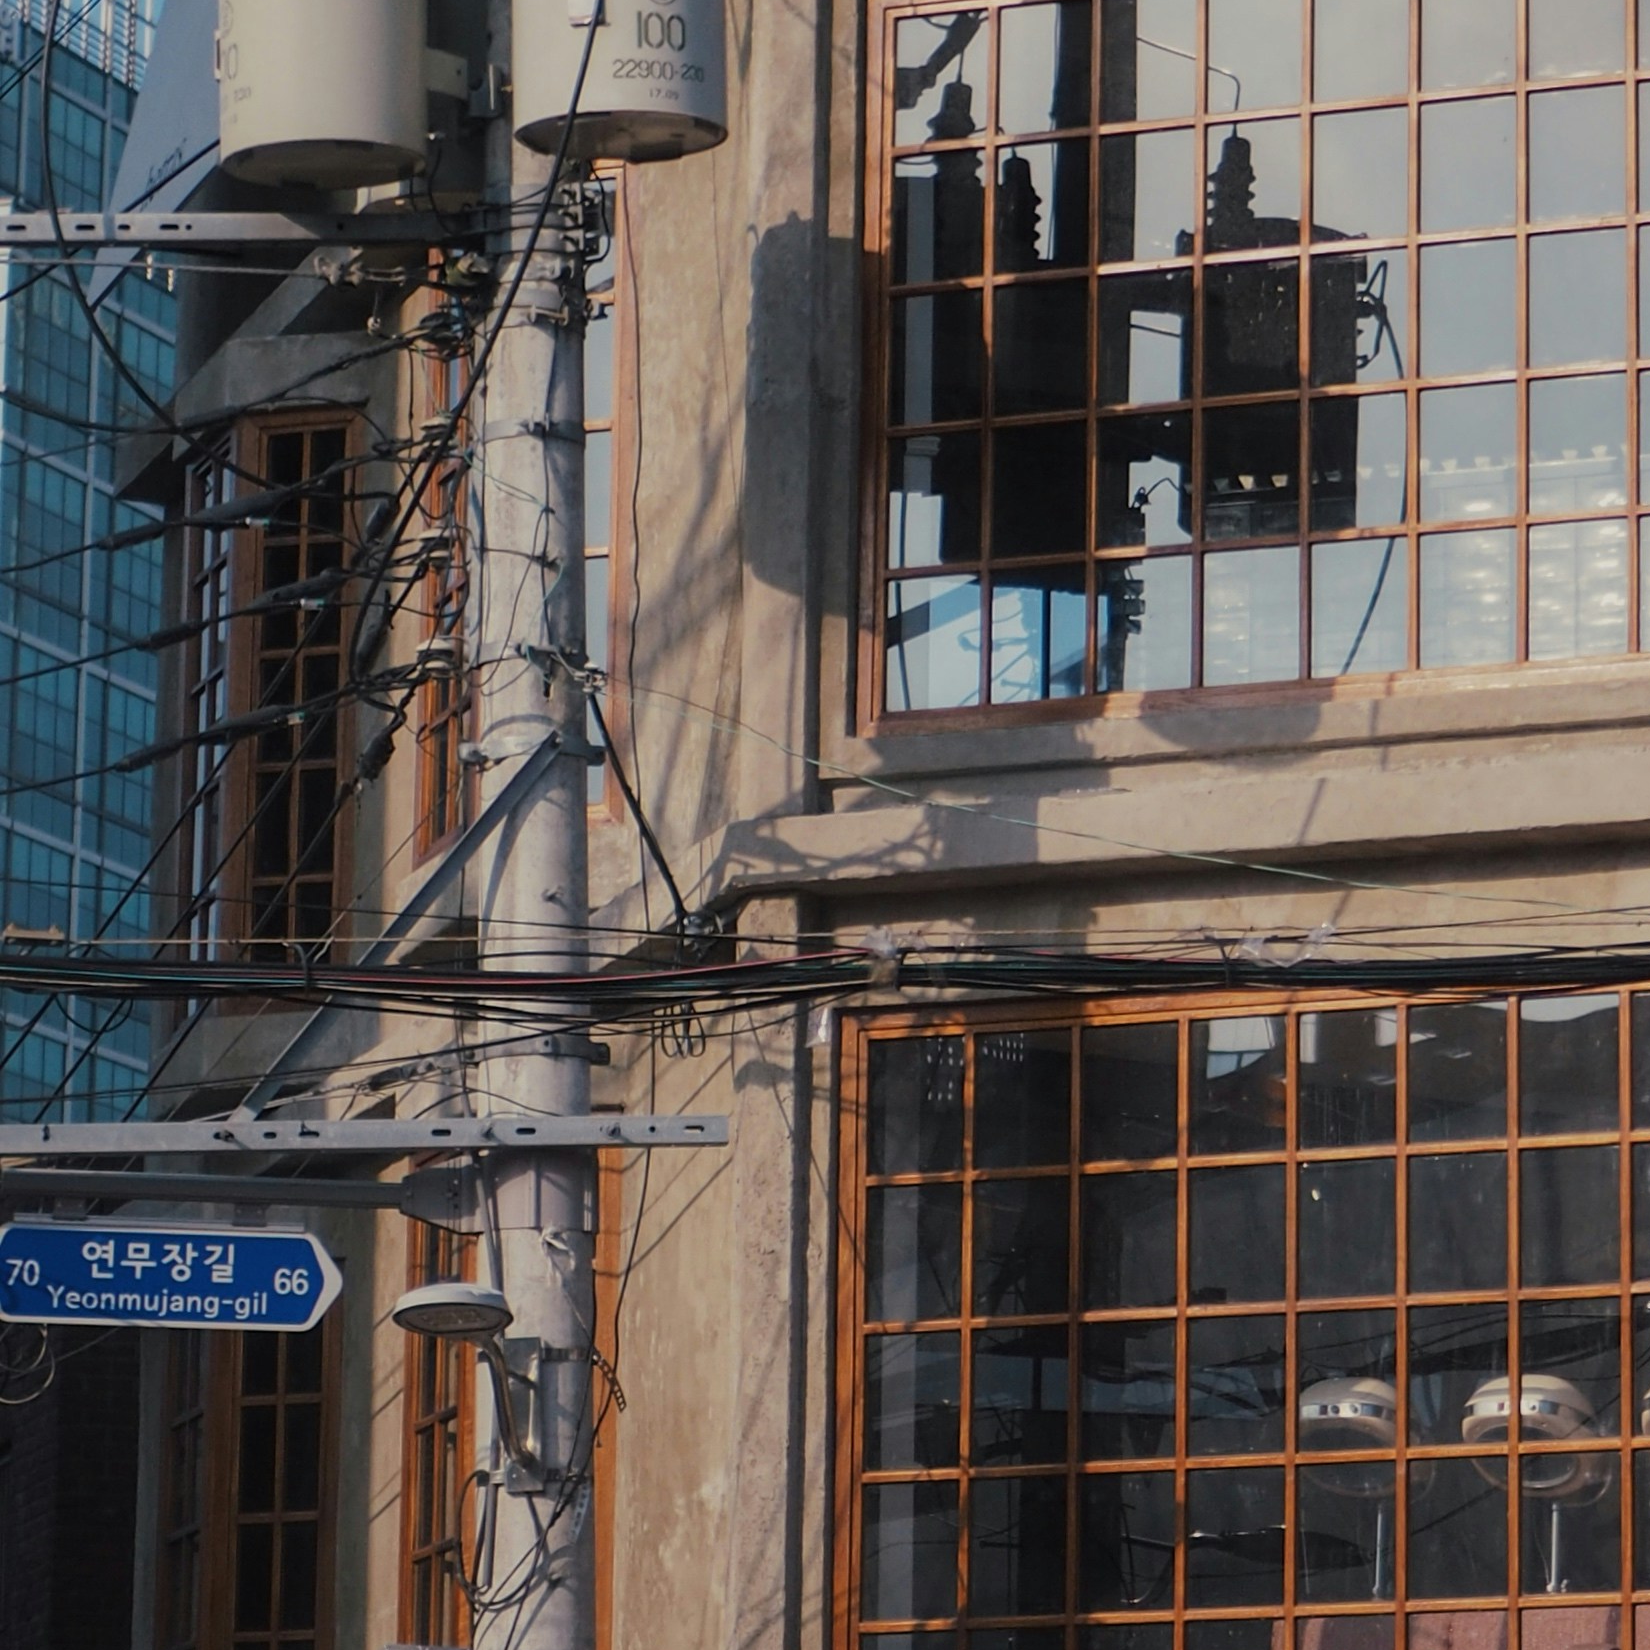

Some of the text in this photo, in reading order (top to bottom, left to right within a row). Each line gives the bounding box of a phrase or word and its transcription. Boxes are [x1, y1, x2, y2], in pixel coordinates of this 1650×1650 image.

[637, 10, 686, 52] 100
[5, 1259, 40, 1287] 70
[81, 1239, 236, 1284] 연무장길
[273, 1268, 309, 1296] 66
[46, 1285, 268, 1319] Yeonmujang-gil
